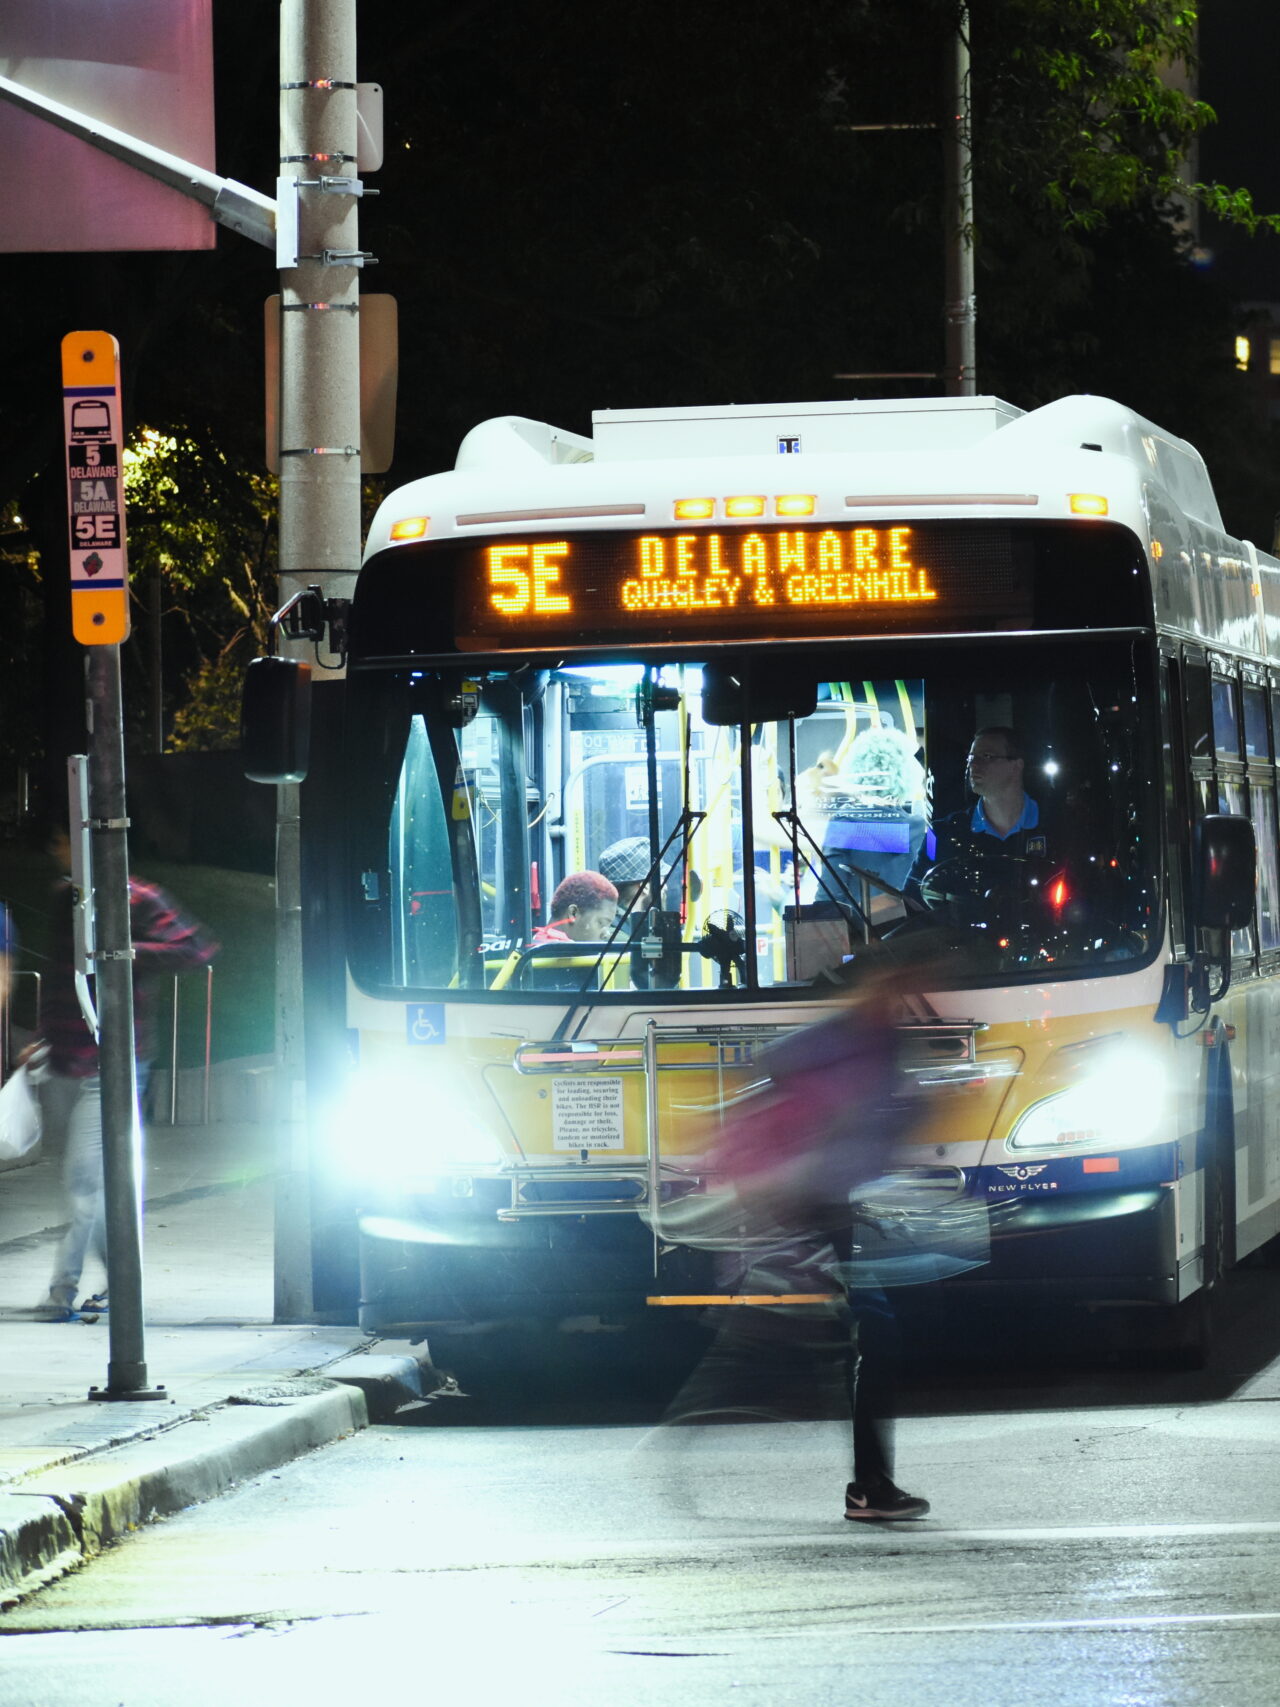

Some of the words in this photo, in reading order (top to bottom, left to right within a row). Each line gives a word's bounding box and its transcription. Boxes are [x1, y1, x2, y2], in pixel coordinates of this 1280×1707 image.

[86, 445, 101, 466] 5
[71, 466, 117, 478] DELAWARE
[80, 481, 109, 501] 5A
[74, 501, 116, 513] DELAWARE
[75, 515, 116, 540] 5E
[638, 527, 914, 578] DELAWARE
[487, 541, 572, 614] 5E
[621, 577, 742, 611] QUIGLEY
[753, 576, 776, 605] &
[786, 569, 939, 605] GREENHILL
[988, 1184, 1017, 1192] NEW
[1020, 1182, 1058, 1190] FLYER
